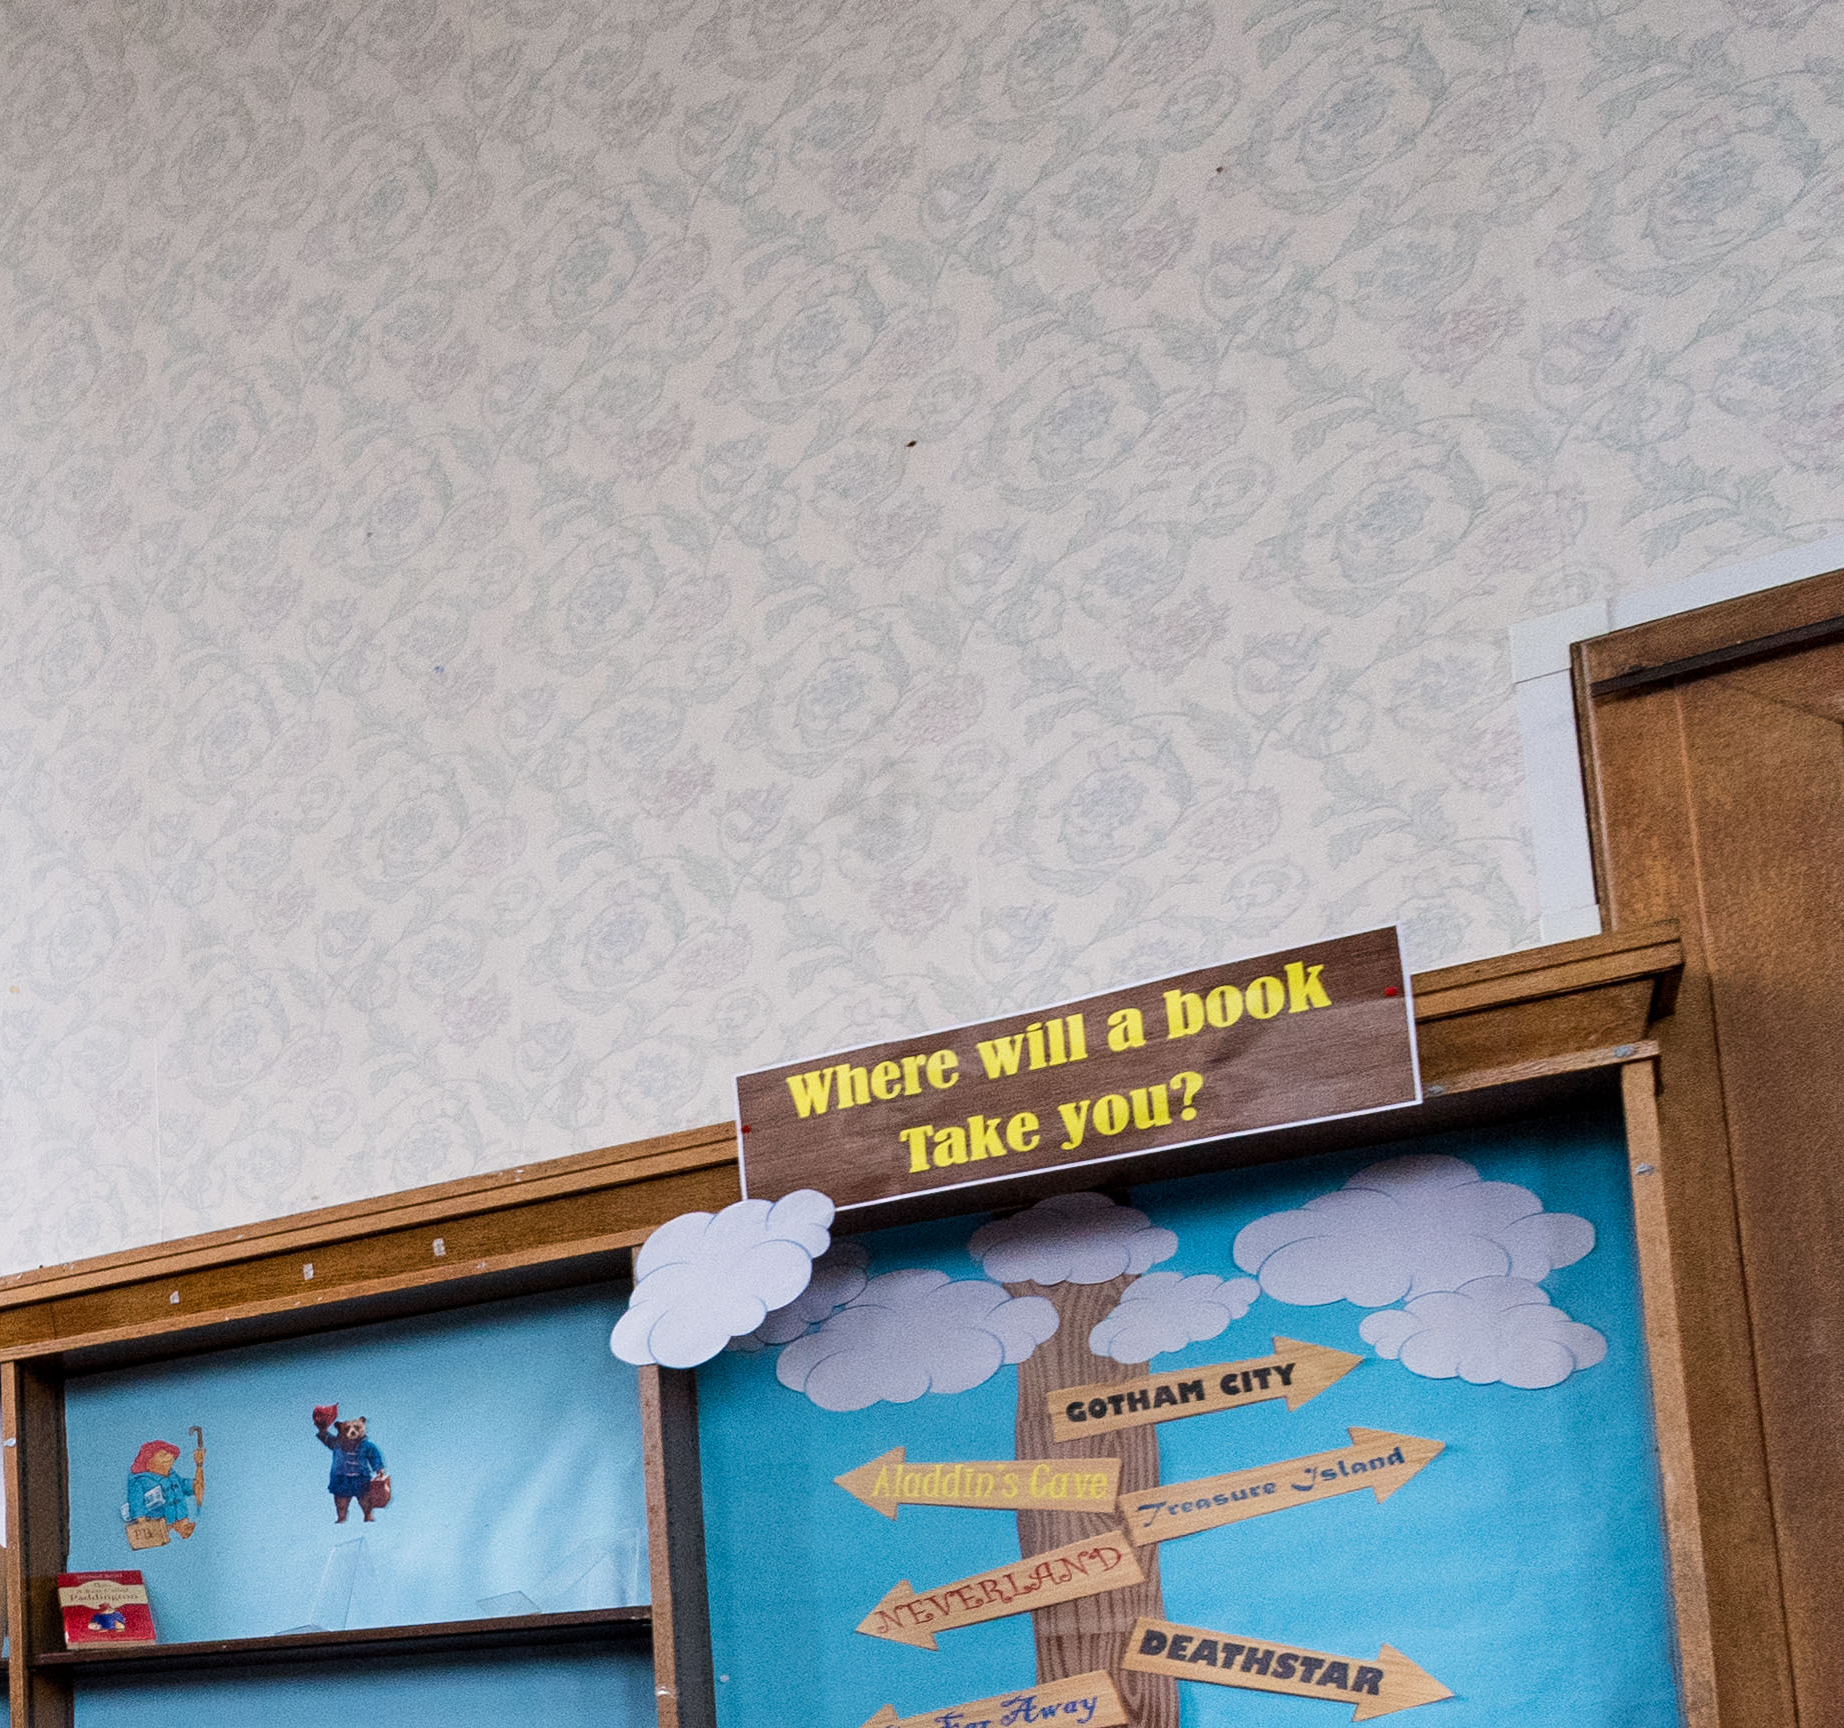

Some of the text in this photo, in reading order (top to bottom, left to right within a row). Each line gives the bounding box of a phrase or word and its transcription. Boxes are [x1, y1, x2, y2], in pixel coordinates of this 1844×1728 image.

[786, 961, 1332, 1119] Where will a book
[899, 1070, 1205, 1174] Take you?
[1065, 1361, 1298, 1423] GOTHAM CITY
[872, 1463, 1108, 1499] Aladdin's Cave
[1136, 1445, 1407, 1528] Treasure Island
[70, 1592, 138, 1602] Paddington
[874, 1542, 1124, 1634] NEVERLAND
[1139, 1629, 1385, 1697] DEATHSTAR
[1000, 1692, 1099, 1727] Away
